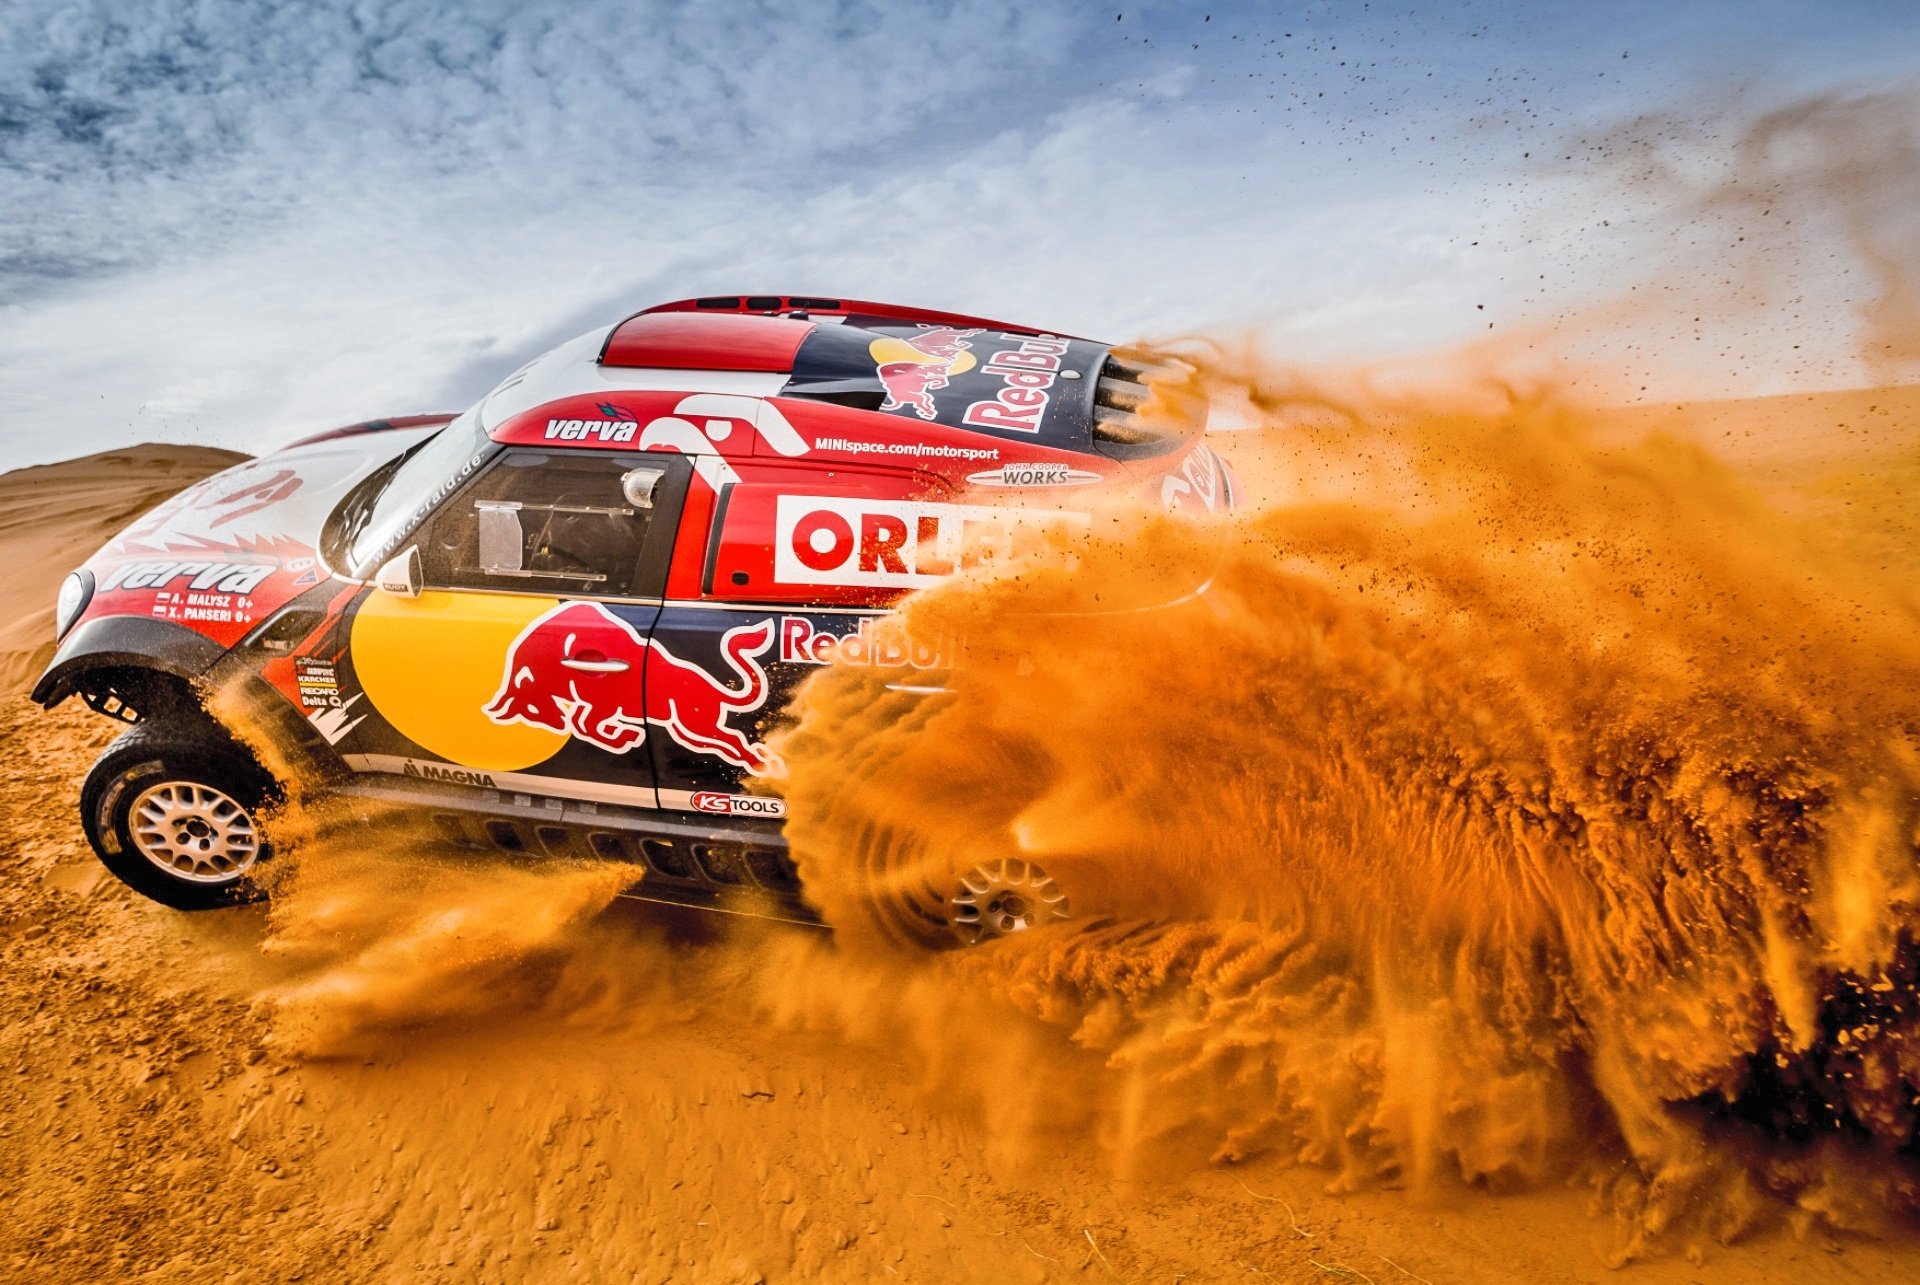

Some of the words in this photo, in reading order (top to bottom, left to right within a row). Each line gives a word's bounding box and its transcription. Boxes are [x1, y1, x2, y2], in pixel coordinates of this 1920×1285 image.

[988, 332, 1071, 373] Bul
[544, 418, 638, 442] verva
[815, 437, 999, 460] MINIspace.com/motorsport
[1004, 463, 1030, 471] JOHN
[1031, 463, 1068, 471] COOPER
[1003, 471, 1067, 485] WORKS
[791, 509, 1078, 577] ORLE
[98, 562, 278, 595] verva
[171, 592, 184, 604] A.
[187, 593, 231, 607] MALYSZ
[168, 606, 181, 618] X.
[184, 607, 232, 622] PANSERI
[302, 696, 327, 705] Delta
[423, 765, 497, 789] MAGNA
[700, 795, 729, 810] KS
[730, 800, 779, 813] TOOLS
